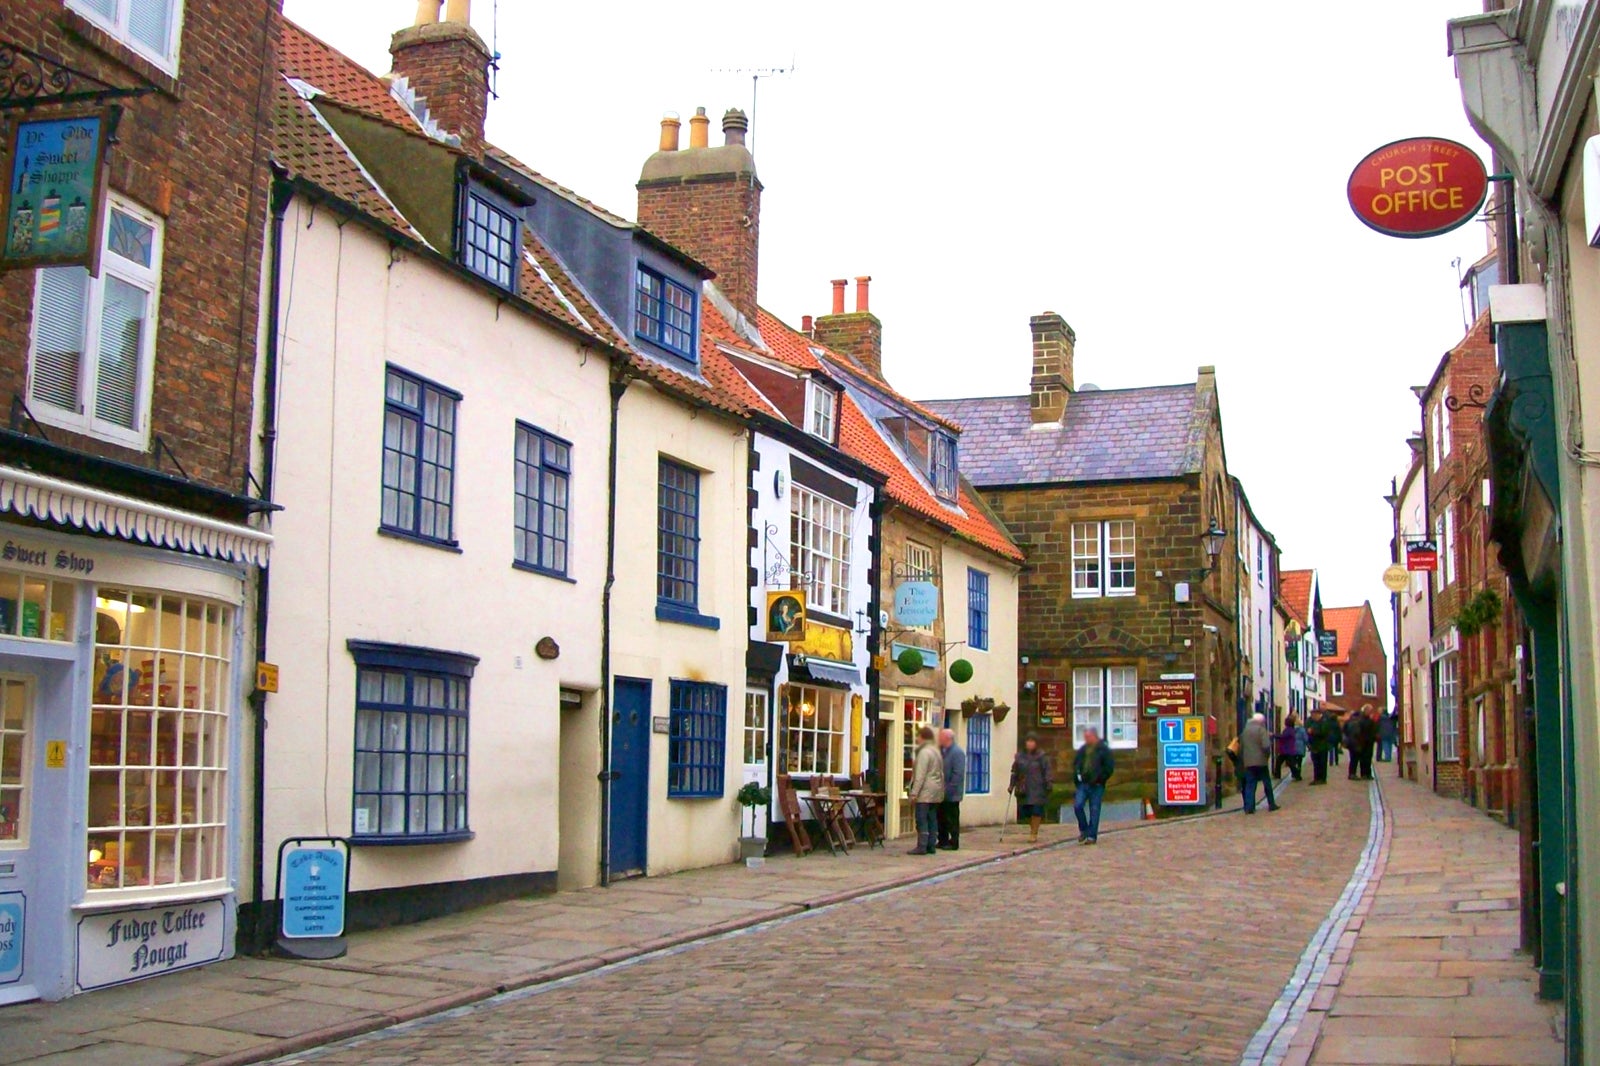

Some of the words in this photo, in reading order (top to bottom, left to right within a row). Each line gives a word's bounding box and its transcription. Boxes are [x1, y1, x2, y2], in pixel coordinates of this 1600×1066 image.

[1371, 145, 1416, 166] CHURCH
[1420, 144, 1459, 158] STREET
[30, 170, 80, 185] Shoppe
[1380, 162, 1449, 189] POST
[1371, 187, 1464, 216] OFFICE
[2, 540, 47, 566] Sweet
[54, 550, 94, 575] Shop
[106, 917, 158, 947] Fudge
[162, 908, 206, 934] Toffee
[128, 940, 189, 973] Nougat
